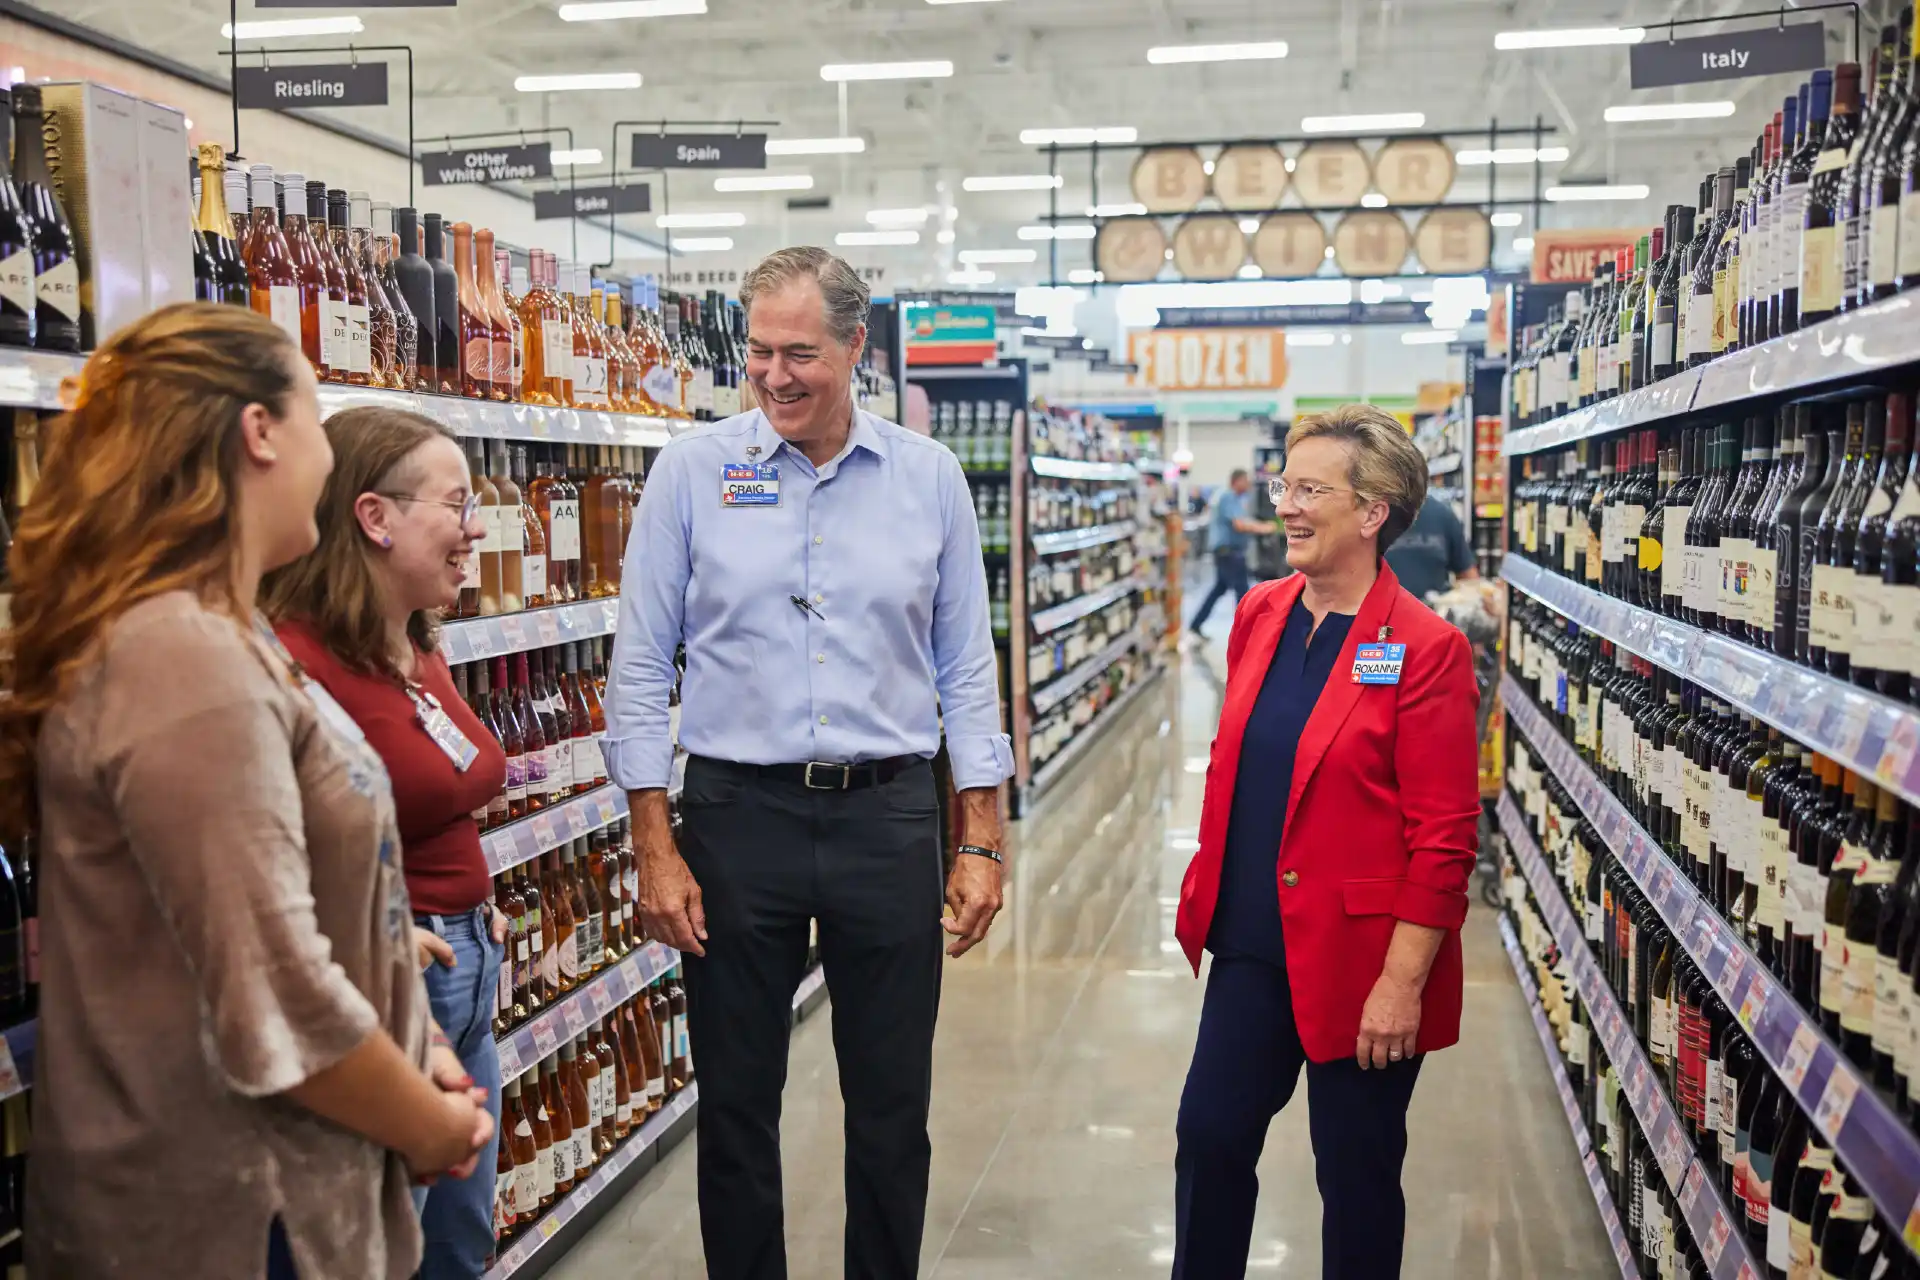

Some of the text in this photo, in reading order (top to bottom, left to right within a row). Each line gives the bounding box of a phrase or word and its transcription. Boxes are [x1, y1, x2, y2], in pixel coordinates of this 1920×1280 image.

[1702, 48, 1749, 69] Italy
[275, 79, 344, 98] Riesling
[465, 152, 508, 168] Other
[677, 144, 720, 163] Spain
[439, 165, 535, 183] White Wines
[1156, 154, 1431, 198] BEER
[575, 196, 608, 211] Sake
[1187, 218, 1471, 267] WINE
[1550, 249, 1594, 279] SAVE
[1133, 331, 1272, 389] FROZEN
[728, 484, 764, 494] CRAIG
[1354, 663, 1400, 674] ROXANNE
